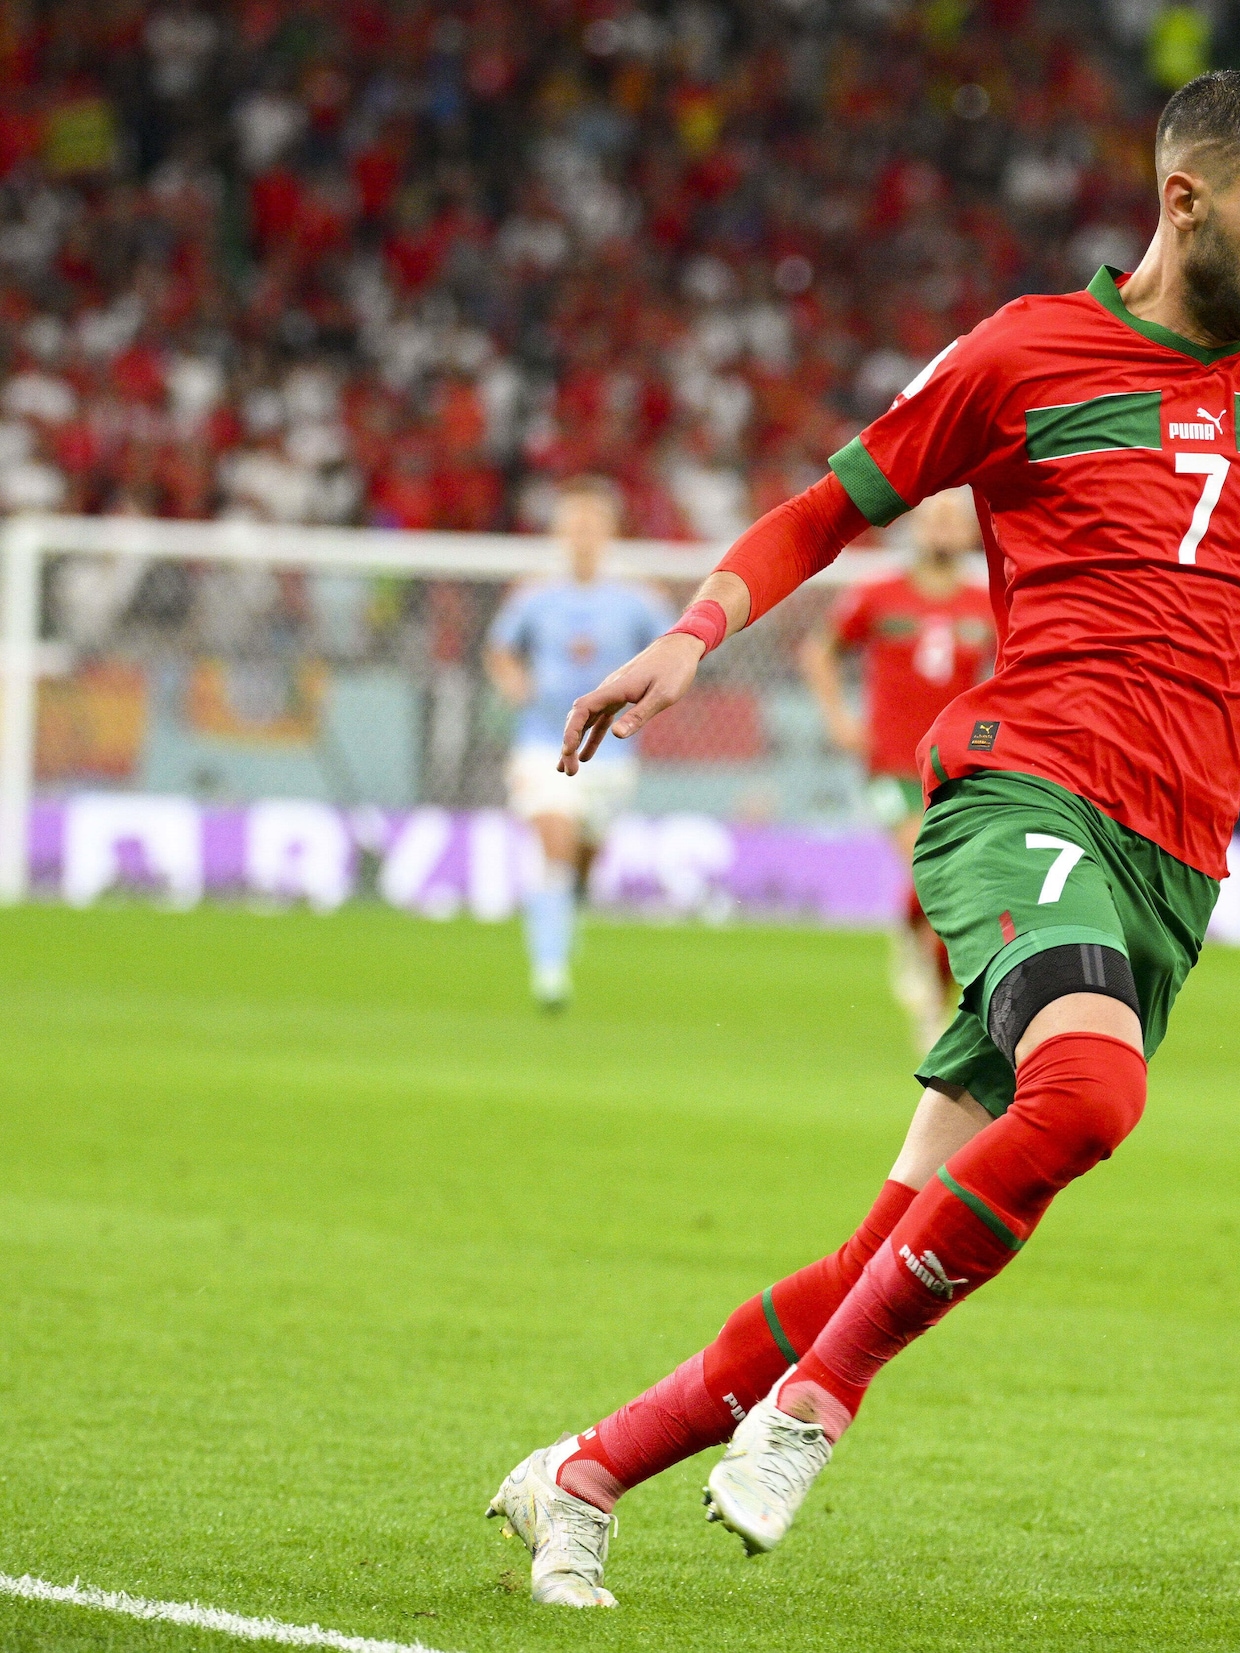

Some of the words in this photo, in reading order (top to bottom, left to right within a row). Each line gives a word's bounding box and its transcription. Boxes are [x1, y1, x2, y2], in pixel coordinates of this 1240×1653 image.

[1169, 422, 1215, 440] PUMA
[1175, 452, 1231, 565] 7
[1025, 832, 1086, 905] 7
[722, 1392, 747, 1422] PU
